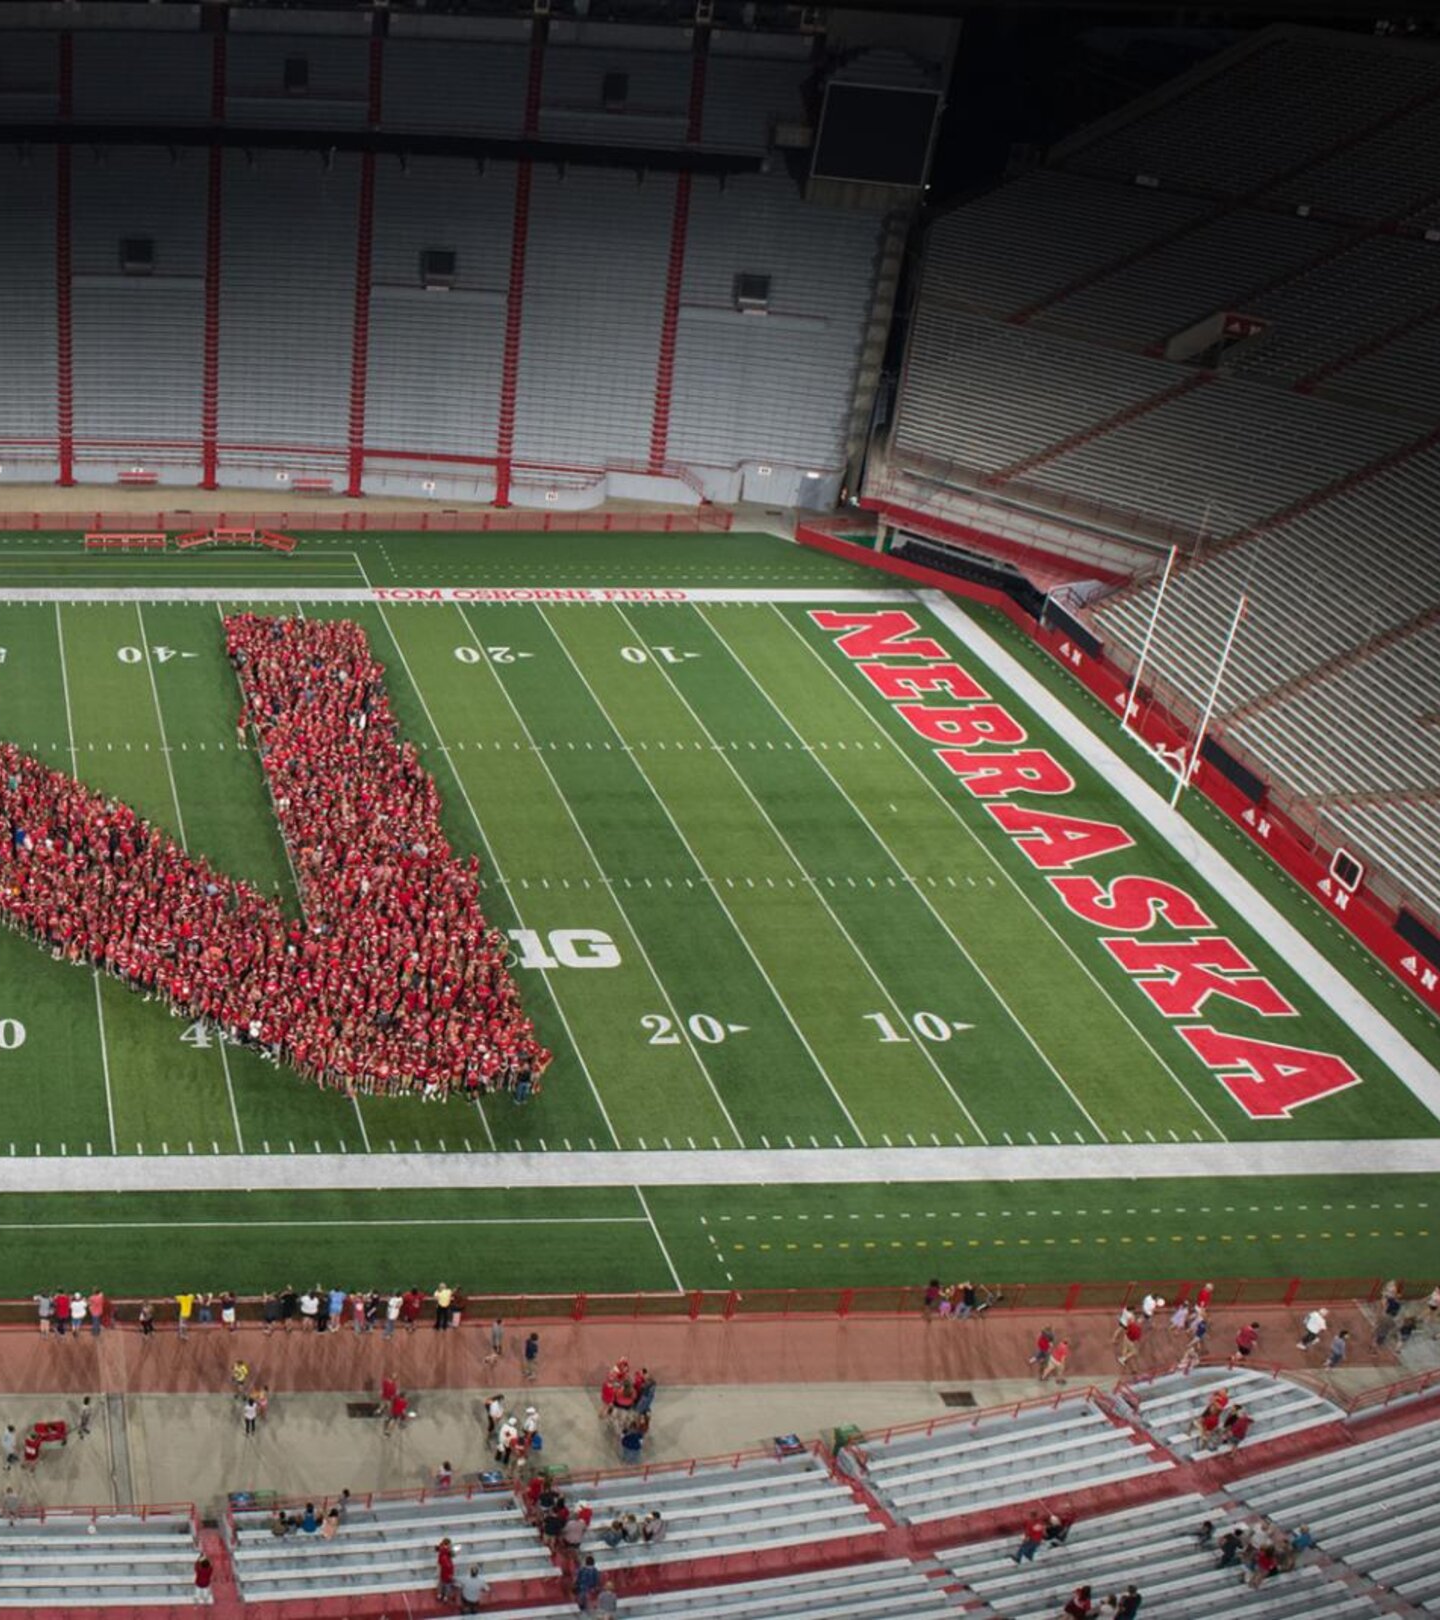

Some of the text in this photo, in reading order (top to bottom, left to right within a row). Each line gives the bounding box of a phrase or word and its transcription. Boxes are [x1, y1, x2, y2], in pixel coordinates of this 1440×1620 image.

[372, 588, 687, 600] TOM OSBORNE FIELD
[807, 610, 1363, 1120] NEBRASKA
